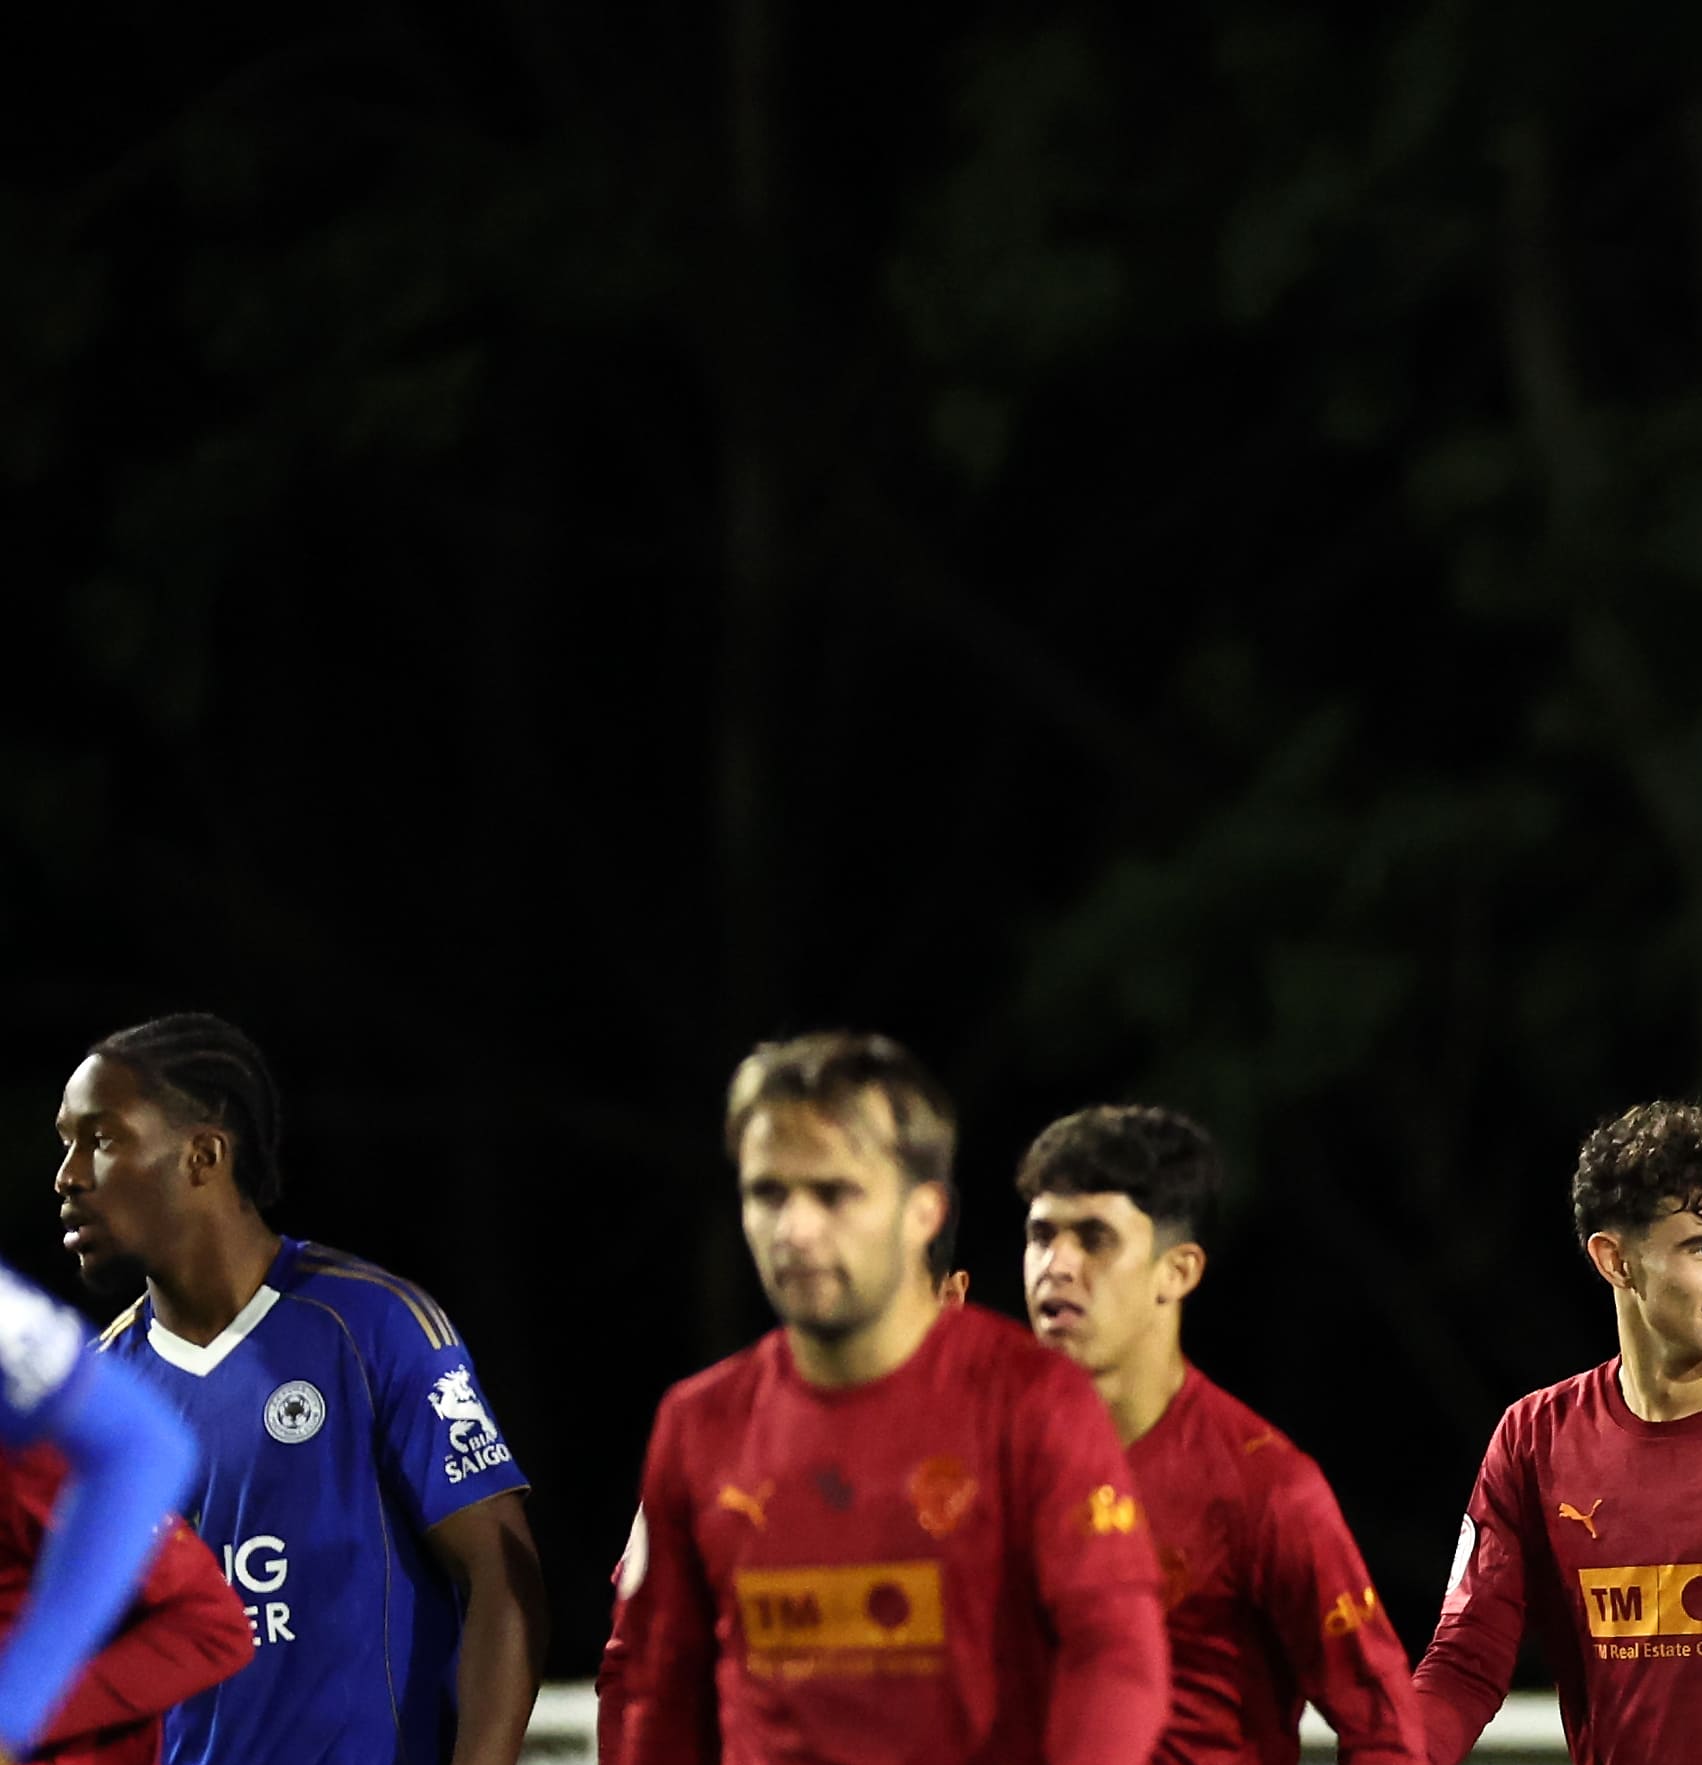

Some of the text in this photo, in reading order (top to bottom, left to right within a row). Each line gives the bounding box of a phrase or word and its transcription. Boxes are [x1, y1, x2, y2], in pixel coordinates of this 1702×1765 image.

[445, 1443, 513, 1483] SAIGO
[1591, 1586, 1643, 1622] TM
[1610, 1642, 1640, 1660] Real
[1643, 1643, 1691, 1658] Estate
